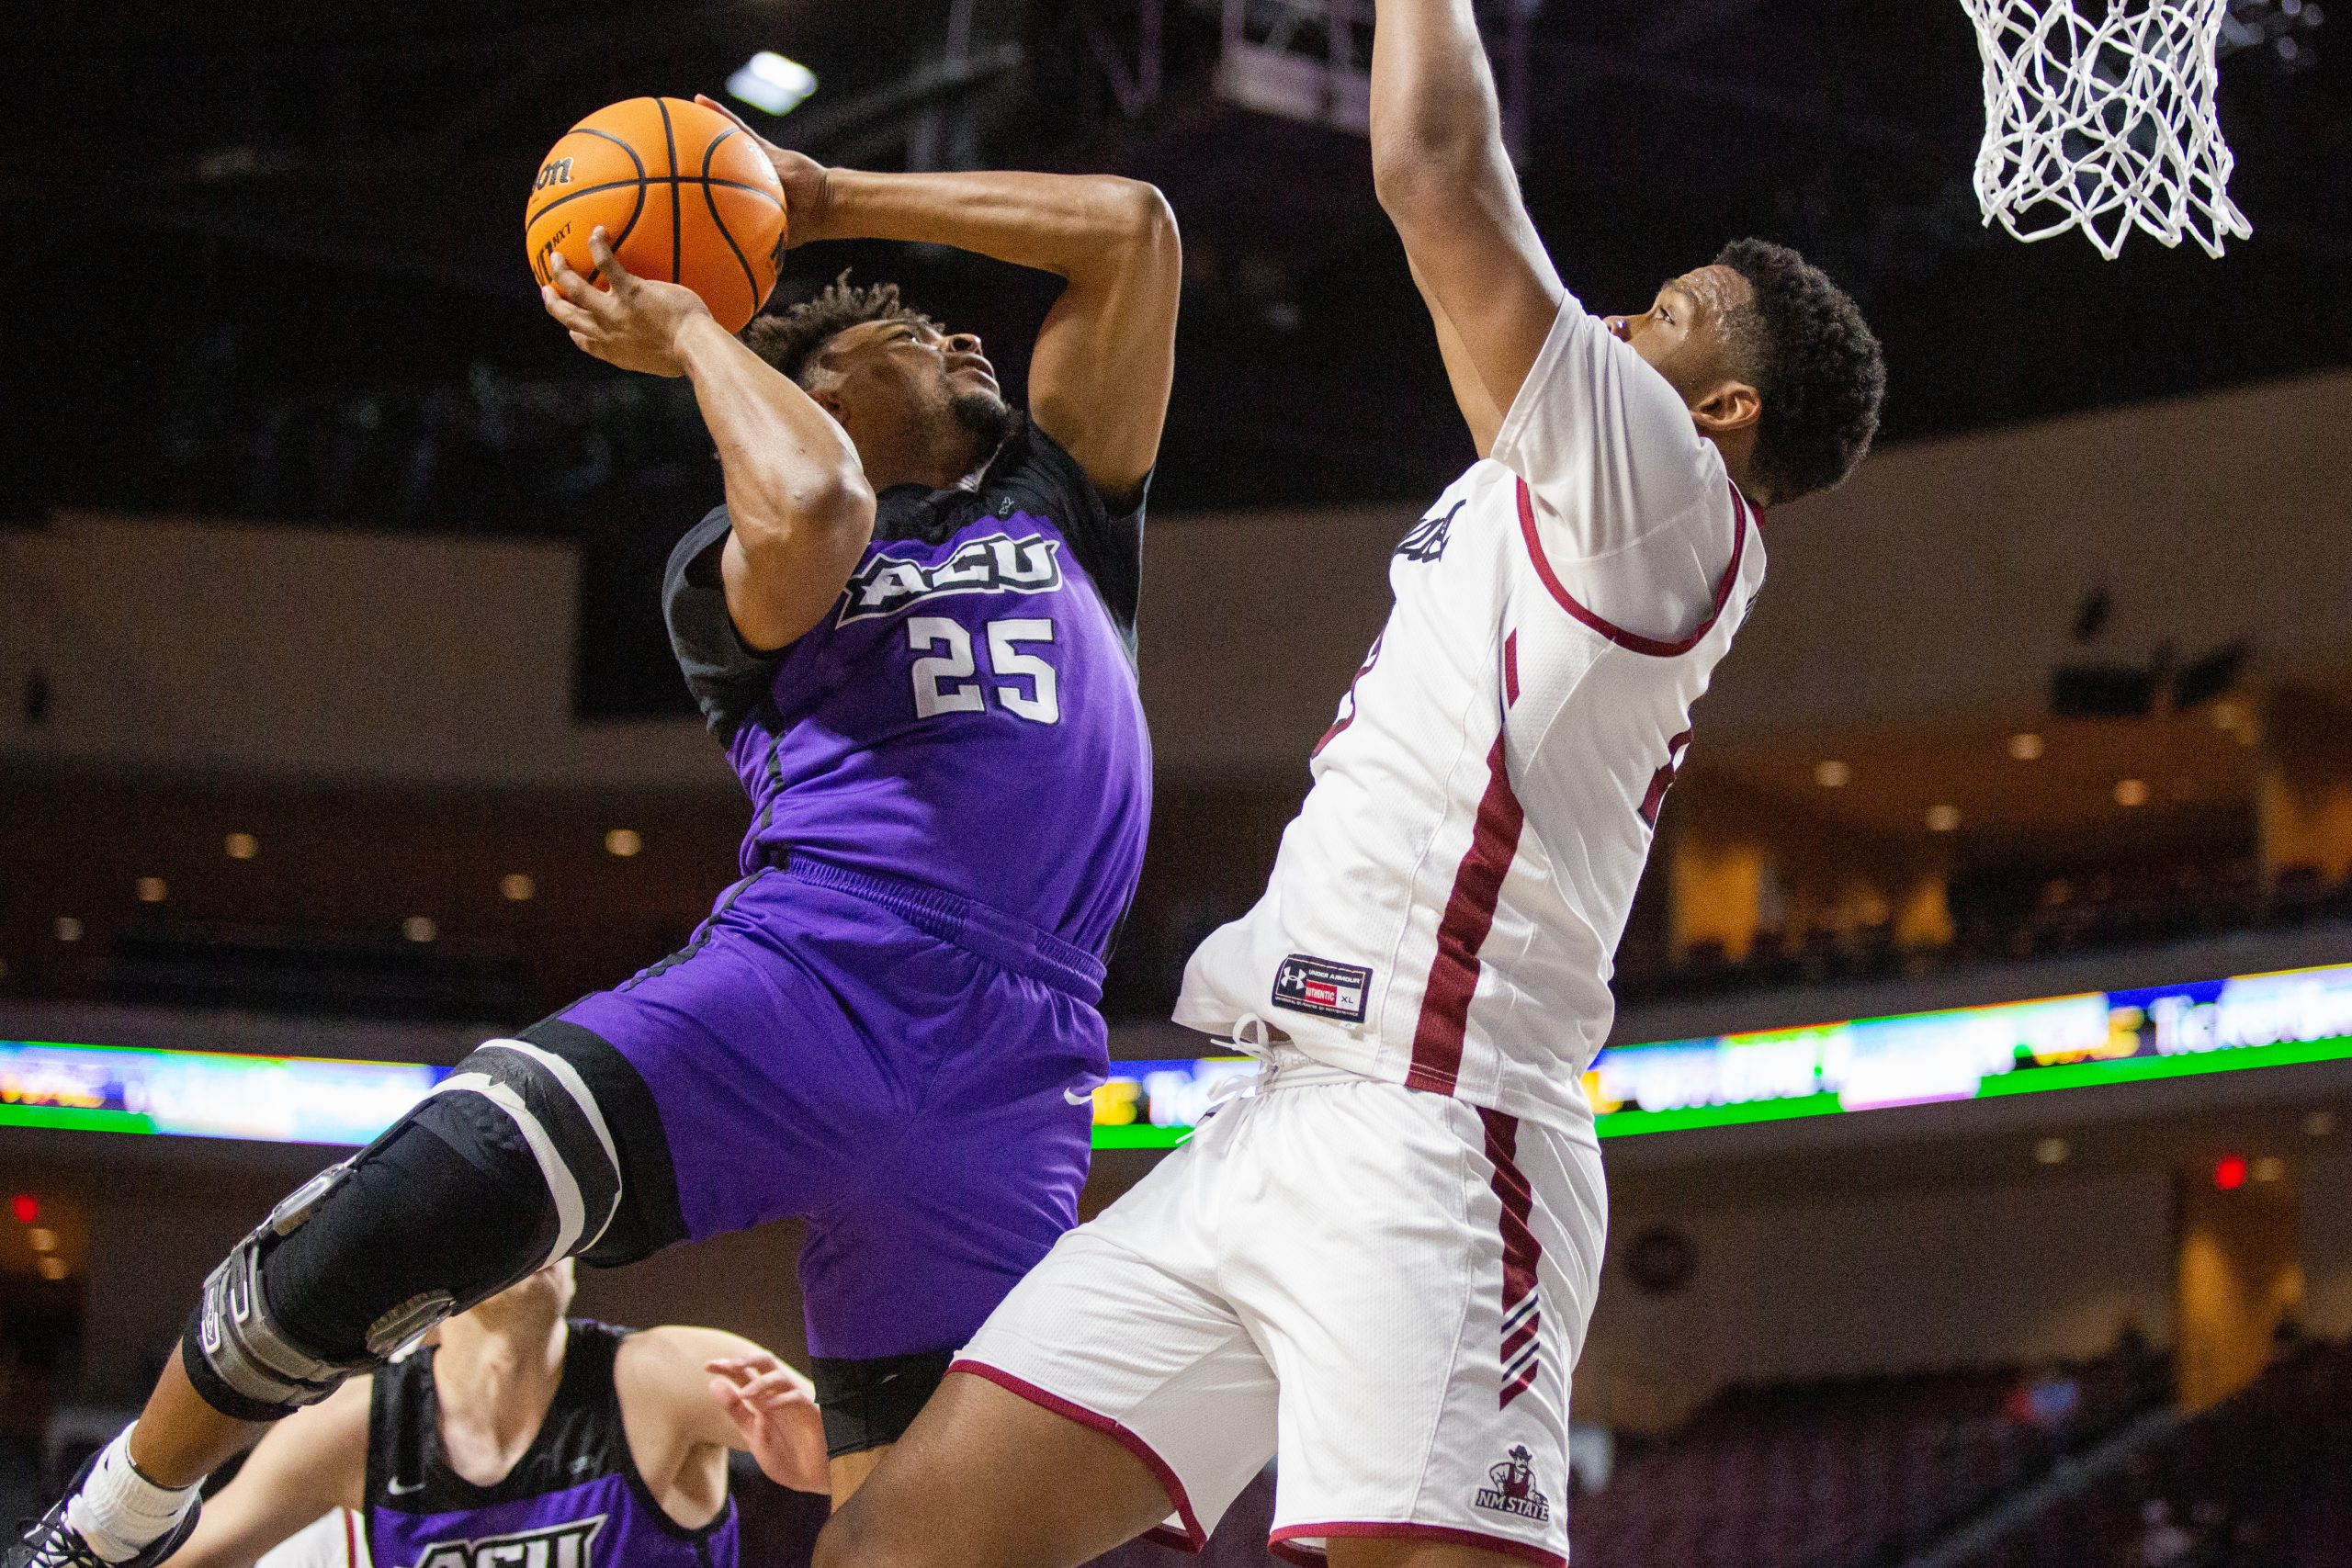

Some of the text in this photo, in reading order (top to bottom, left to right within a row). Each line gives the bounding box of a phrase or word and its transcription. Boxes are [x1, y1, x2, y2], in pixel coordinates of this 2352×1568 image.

[552, 221, 571, 248] NXT
[857, 539, 1056, 607] ACU
[908, 616, 1059, 724] 25
[1308, 969, 1361, 985] UNDER ARMOUR
[1306, 987, 1335, 1001] AUTHENTIC
[1341, 995, 1354, 1004] XL
[1477, 1490, 1549, 1520] NM STATE
